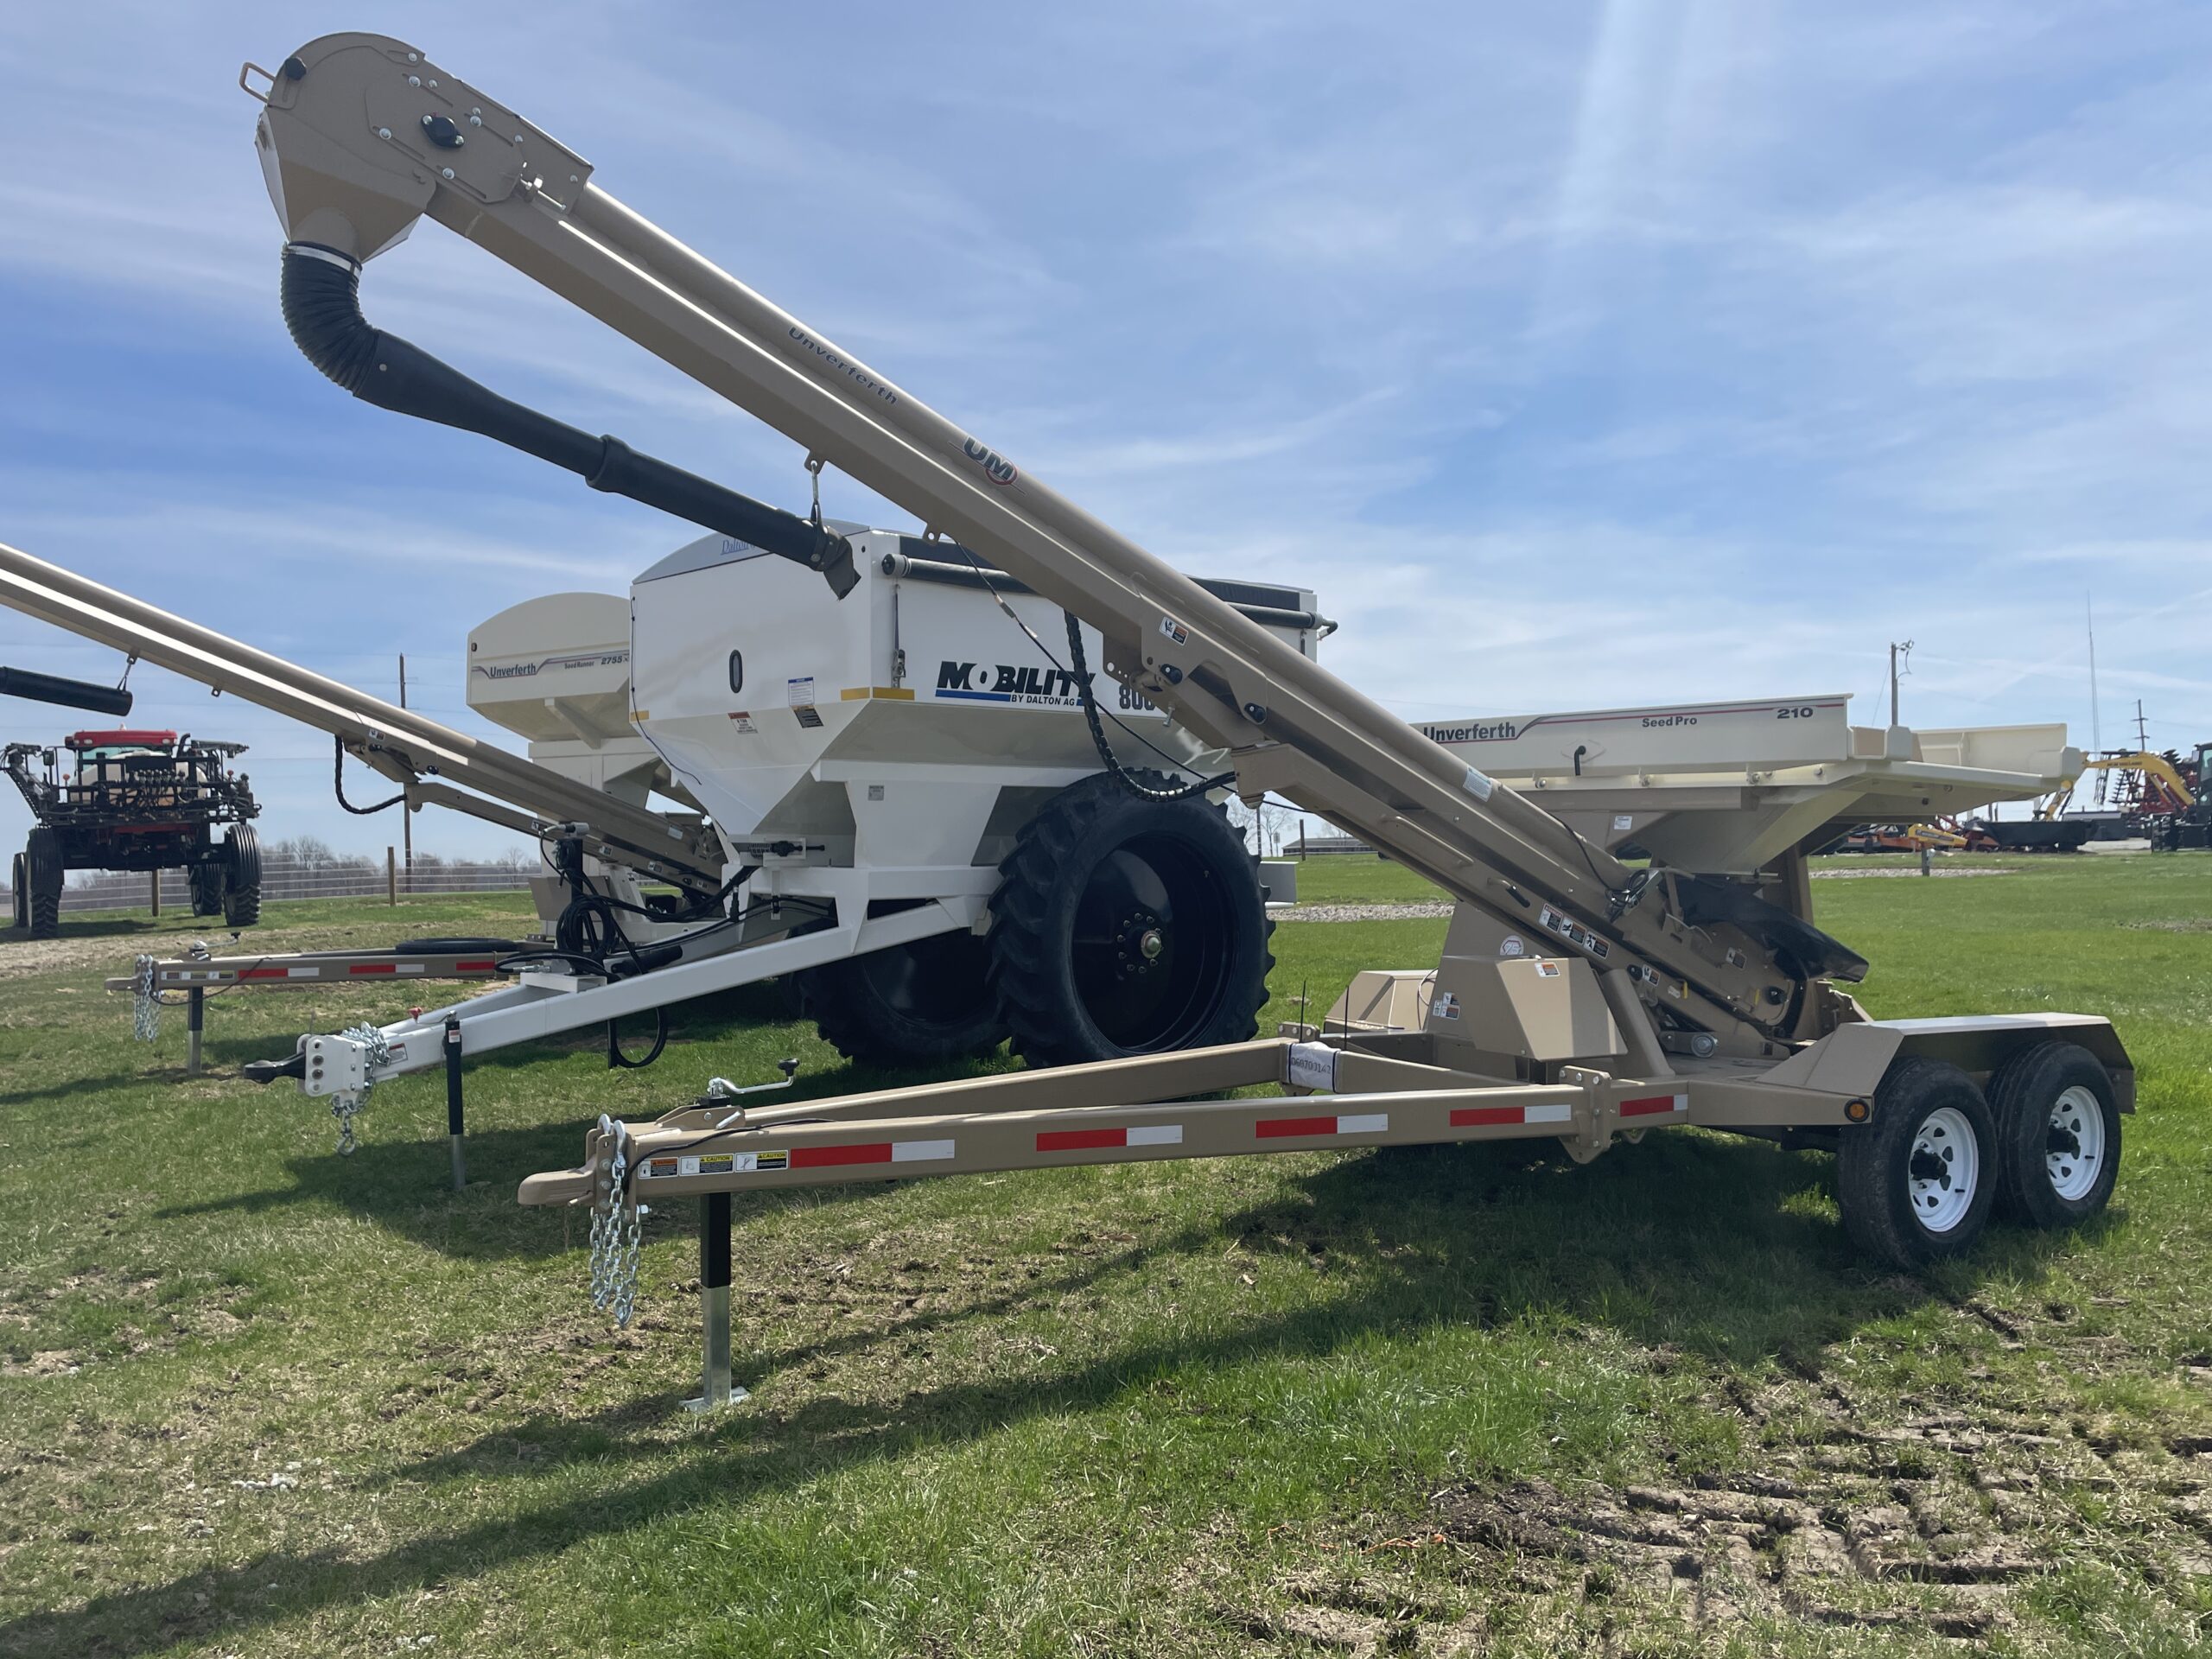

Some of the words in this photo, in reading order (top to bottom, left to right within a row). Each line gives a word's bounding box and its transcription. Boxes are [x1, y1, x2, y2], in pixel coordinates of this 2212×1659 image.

[788, 327, 897, 404] Unverferth
[601, 655, 623, 665] 2755
[490, 663, 537, 678] Unverferth
[938, 660, 1096, 697] MOBILIT
[1011, 694, 1024, 703] BY
[1026, 695, 1061, 705] DALTON
[1063, 697, 1075, 706] AG
[1777, 707, 1814, 719] 210
[1642, 717, 1674, 728] Seed
[1675, 715, 1698, 726] Pro
[1424, 721, 1516, 741] Unverferth
